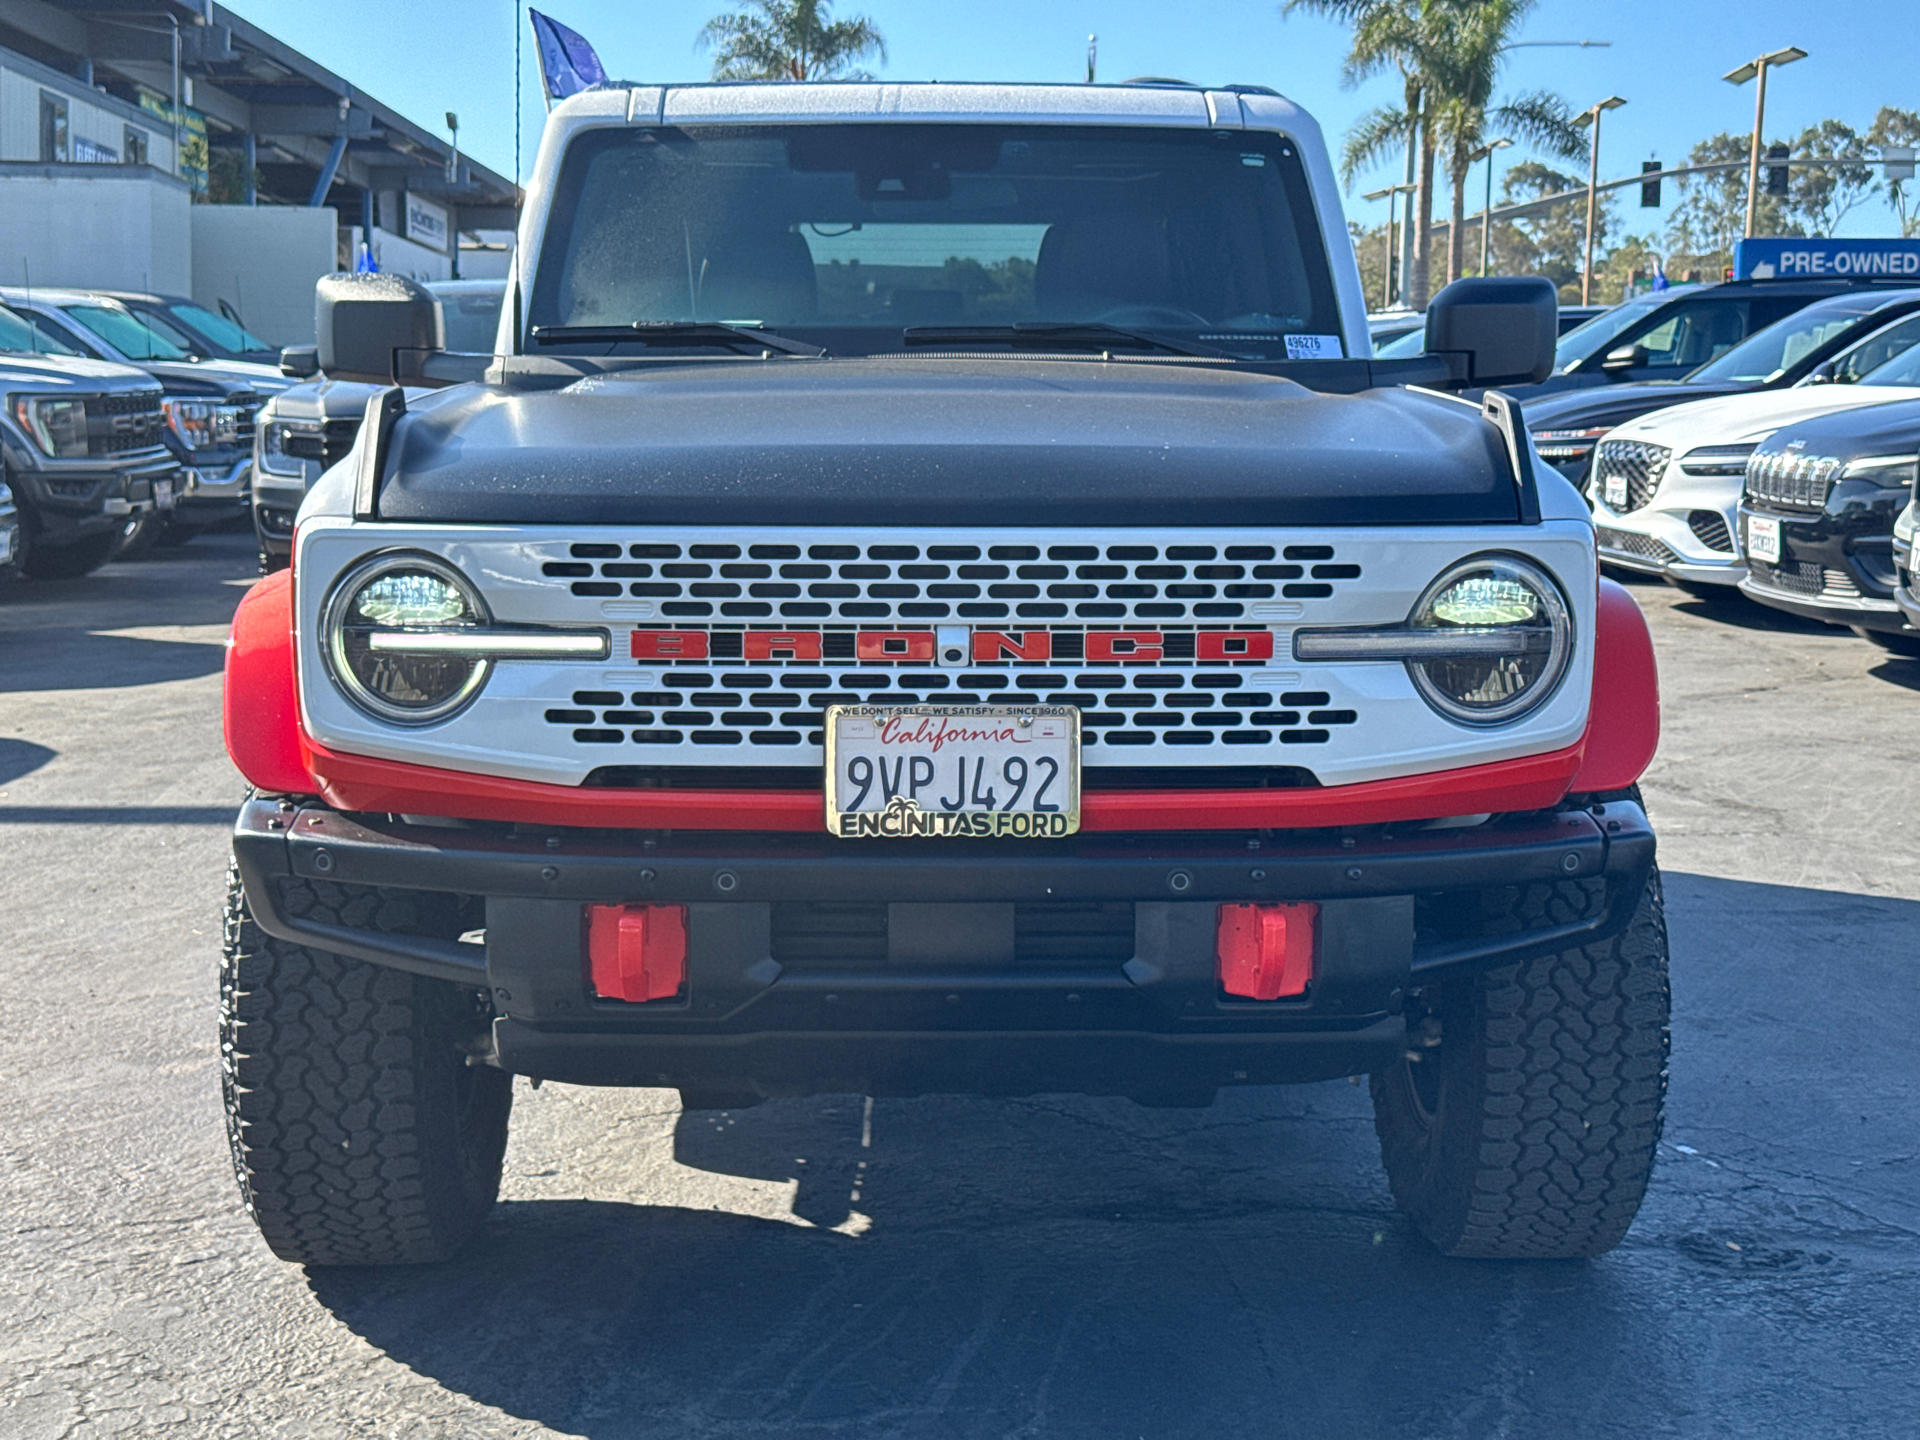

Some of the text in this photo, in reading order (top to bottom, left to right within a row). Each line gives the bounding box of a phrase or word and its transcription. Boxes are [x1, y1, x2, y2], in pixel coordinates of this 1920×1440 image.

[1780, 252, 1919, 274] PRE-OWNED
[1287, 336, 1321, 350] 496276
[631, 631, 1274, 661] BRONCO
[842, 707, 859, 715] WE
[861, 706, 892, 715] DON'T
[933, 707, 949, 715] WE
[952, 707, 995, 715] SATISFY
[1006, 707, 1038, 715] SINCE
[1039, 707, 1066, 715] 1960
[881, 717, 1032, 753] California
[840, 812, 1068, 836] ENCINITAS FORD
